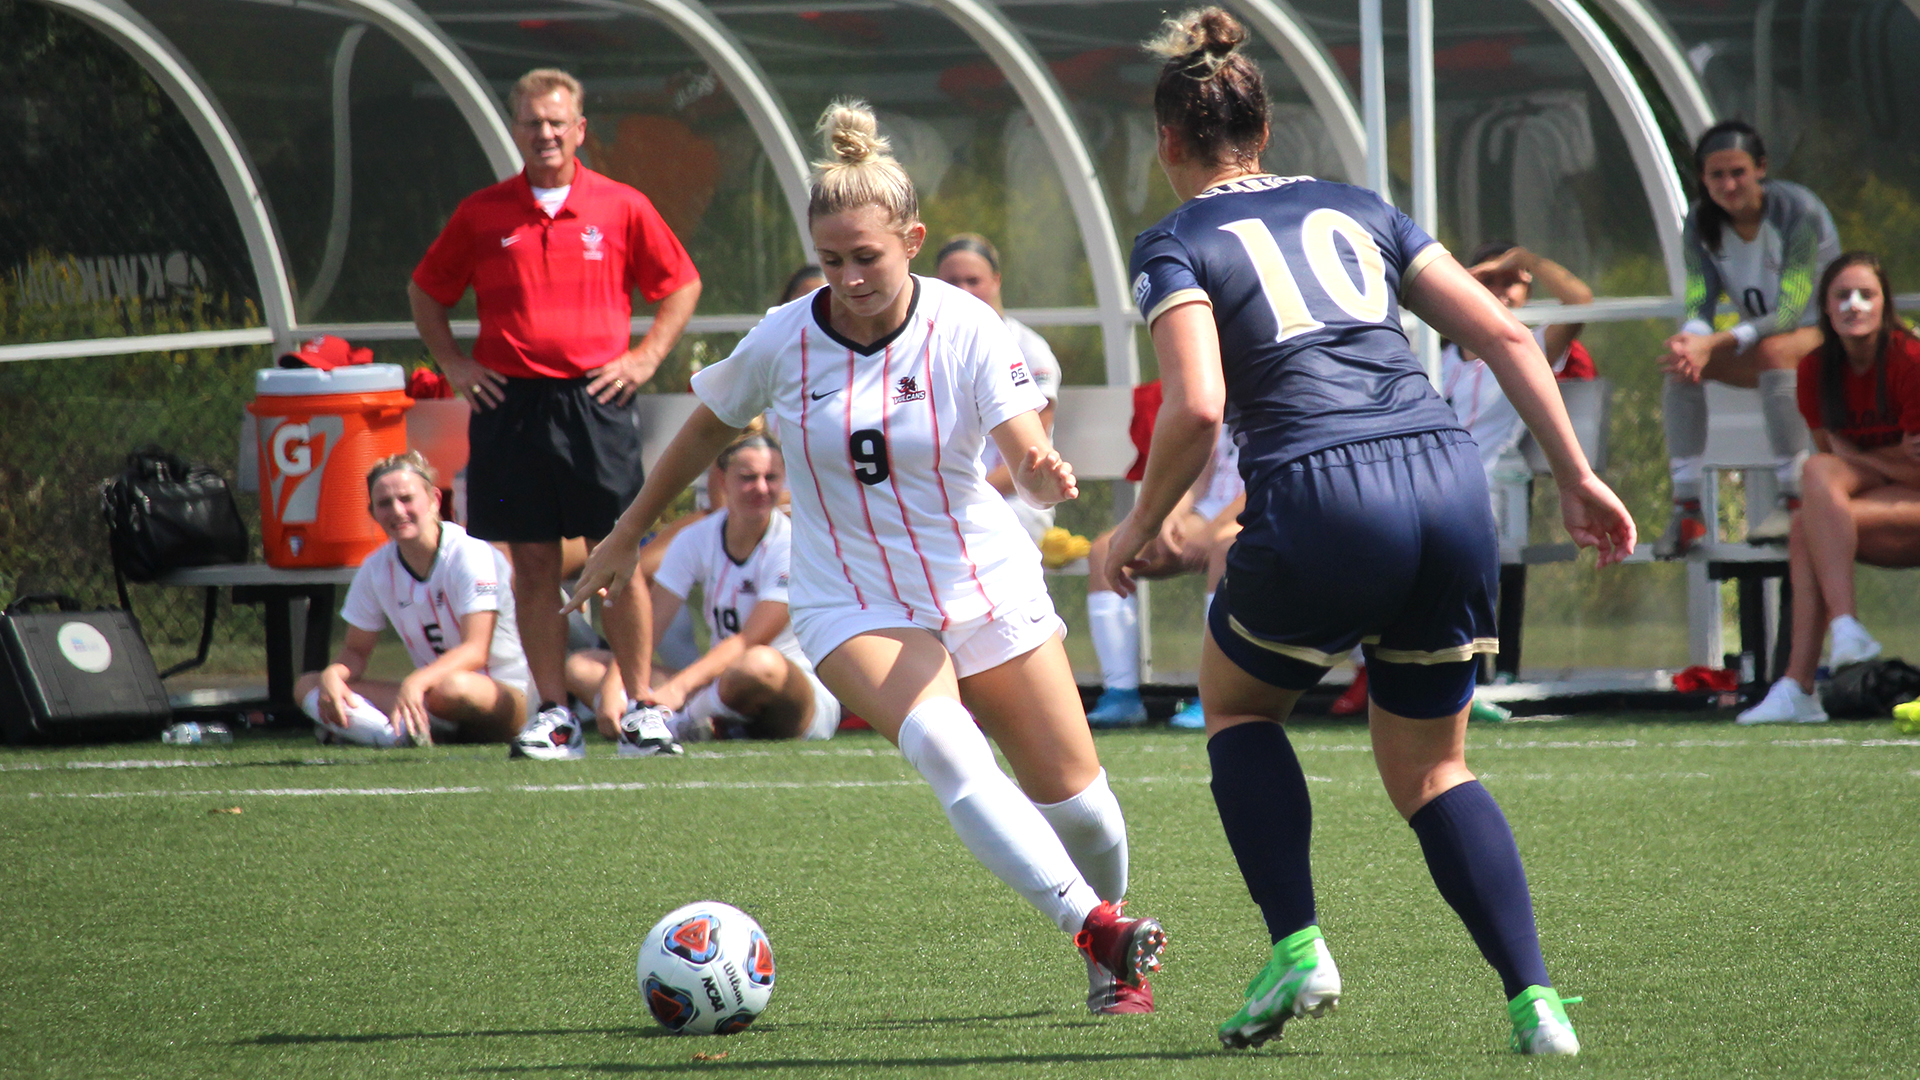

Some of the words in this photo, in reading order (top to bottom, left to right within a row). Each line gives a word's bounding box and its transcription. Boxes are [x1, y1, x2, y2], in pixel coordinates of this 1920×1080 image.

[1217, 207, 1389, 343] 10
[893, 391, 926, 404] VULCANS
[850, 428, 890, 486] 9
[423, 623, 447, 655] 5
[713, 606, 741, 640] 19
[702, 976, 726, 1013] NCAA
[723, 960, 745, 1006] Wilson
